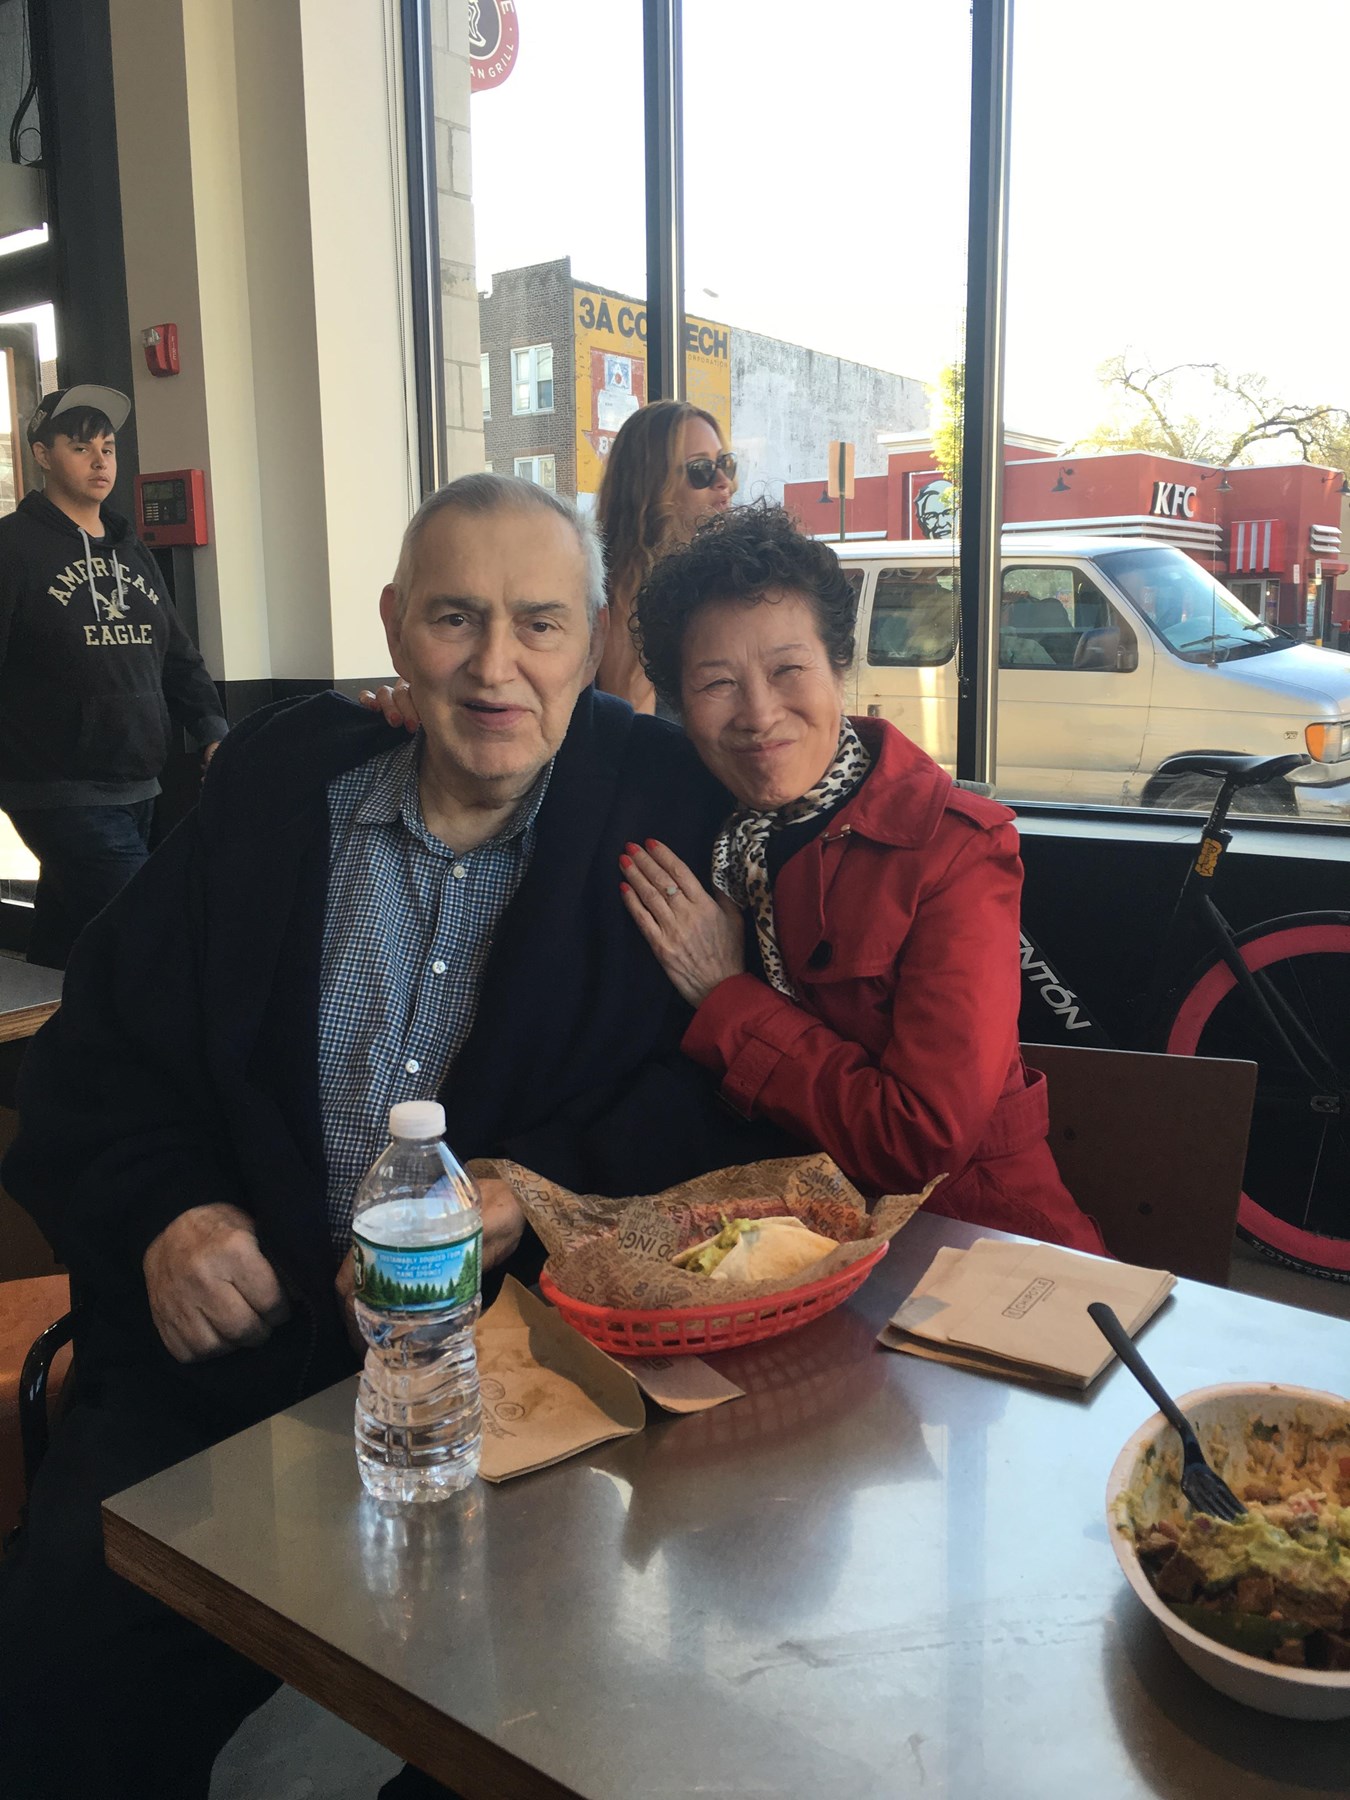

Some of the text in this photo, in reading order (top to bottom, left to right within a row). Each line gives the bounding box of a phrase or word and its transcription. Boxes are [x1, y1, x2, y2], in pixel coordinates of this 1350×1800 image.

[488, 43, 515, 78] GRILL
[579, 297, 614, 335] 3A
[688, 354, 728, 369] ORPORATION
[1153, 481, 1197, 518] KFC
[47, 556, 161, 607] AMERICAN
[84, 624, 153, 647] EAGLE
